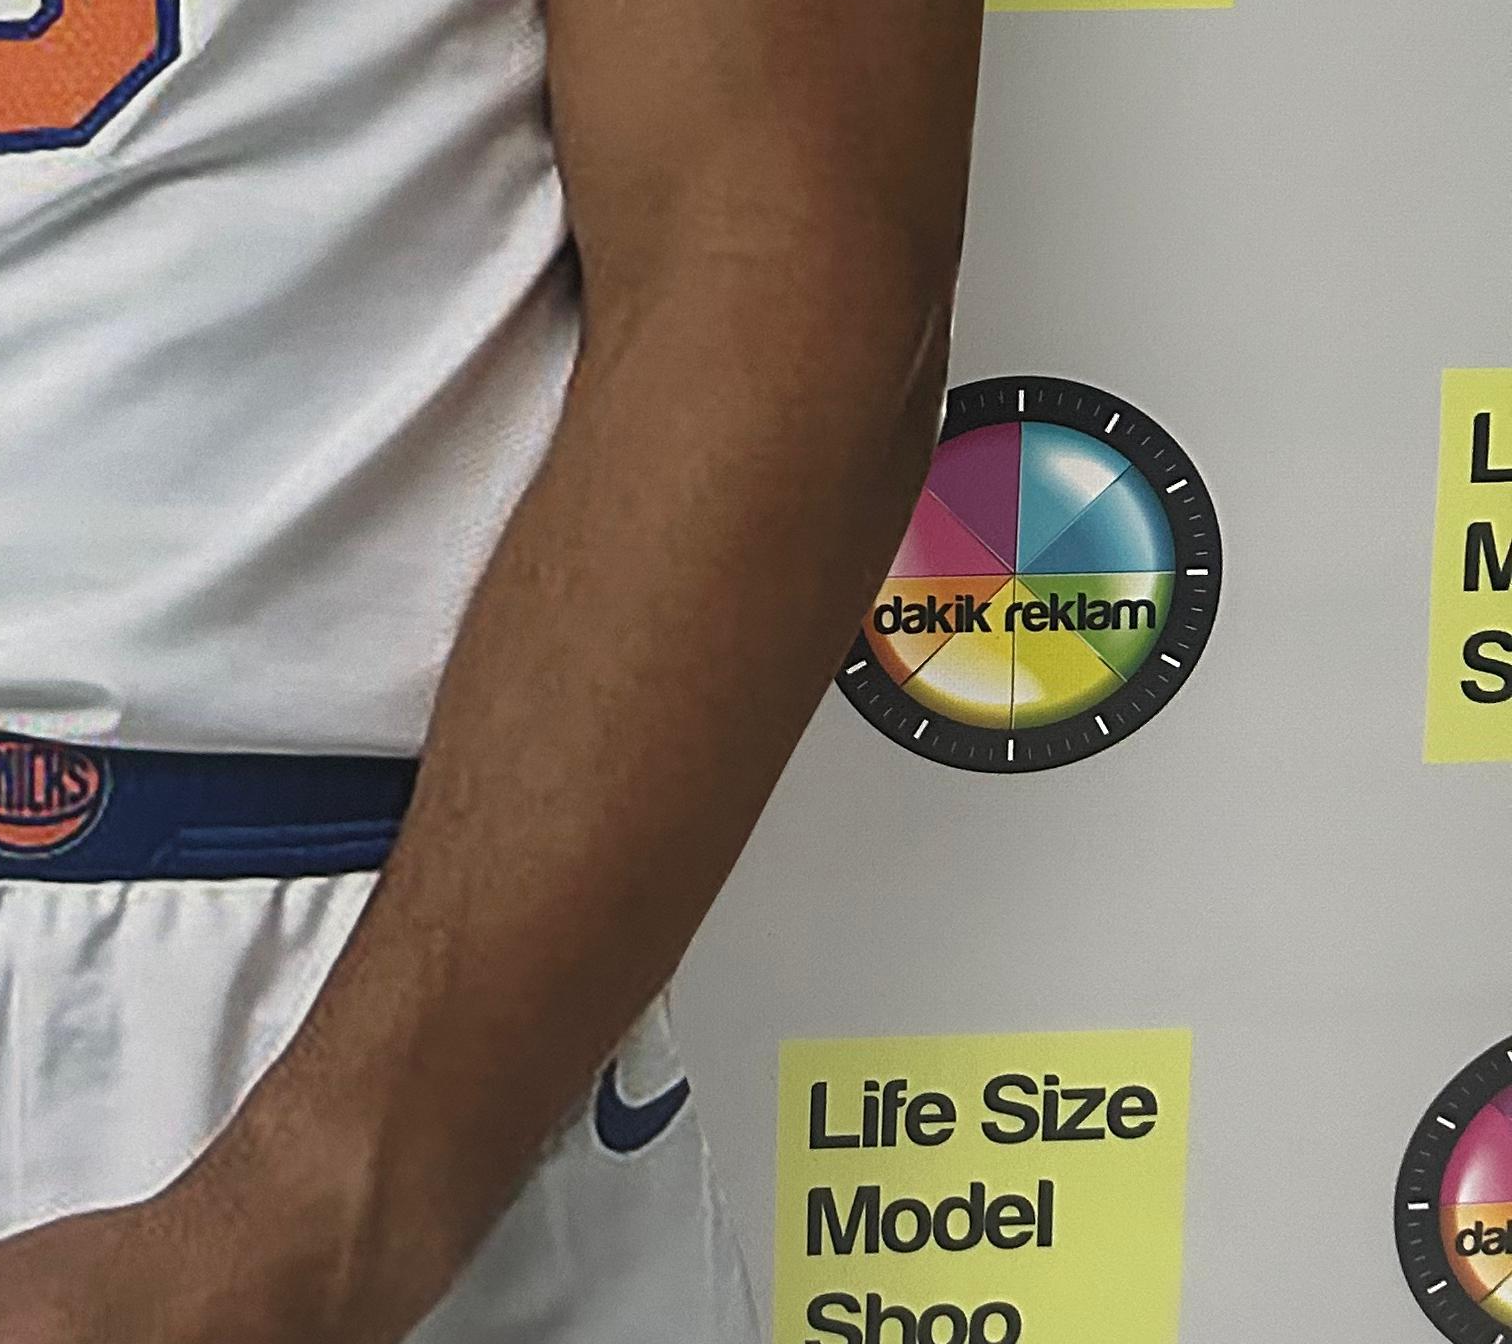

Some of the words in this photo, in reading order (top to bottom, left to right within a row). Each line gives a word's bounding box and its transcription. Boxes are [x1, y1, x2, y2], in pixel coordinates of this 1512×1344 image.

[872, 594, 992, 635] dakik
[1004, 593, 1156, 633] reklam
[809, 1078, 957, 1150] Life
[981, 1074, 1158, 1145] Size
[806, 1179, 1054, 1257] Model
